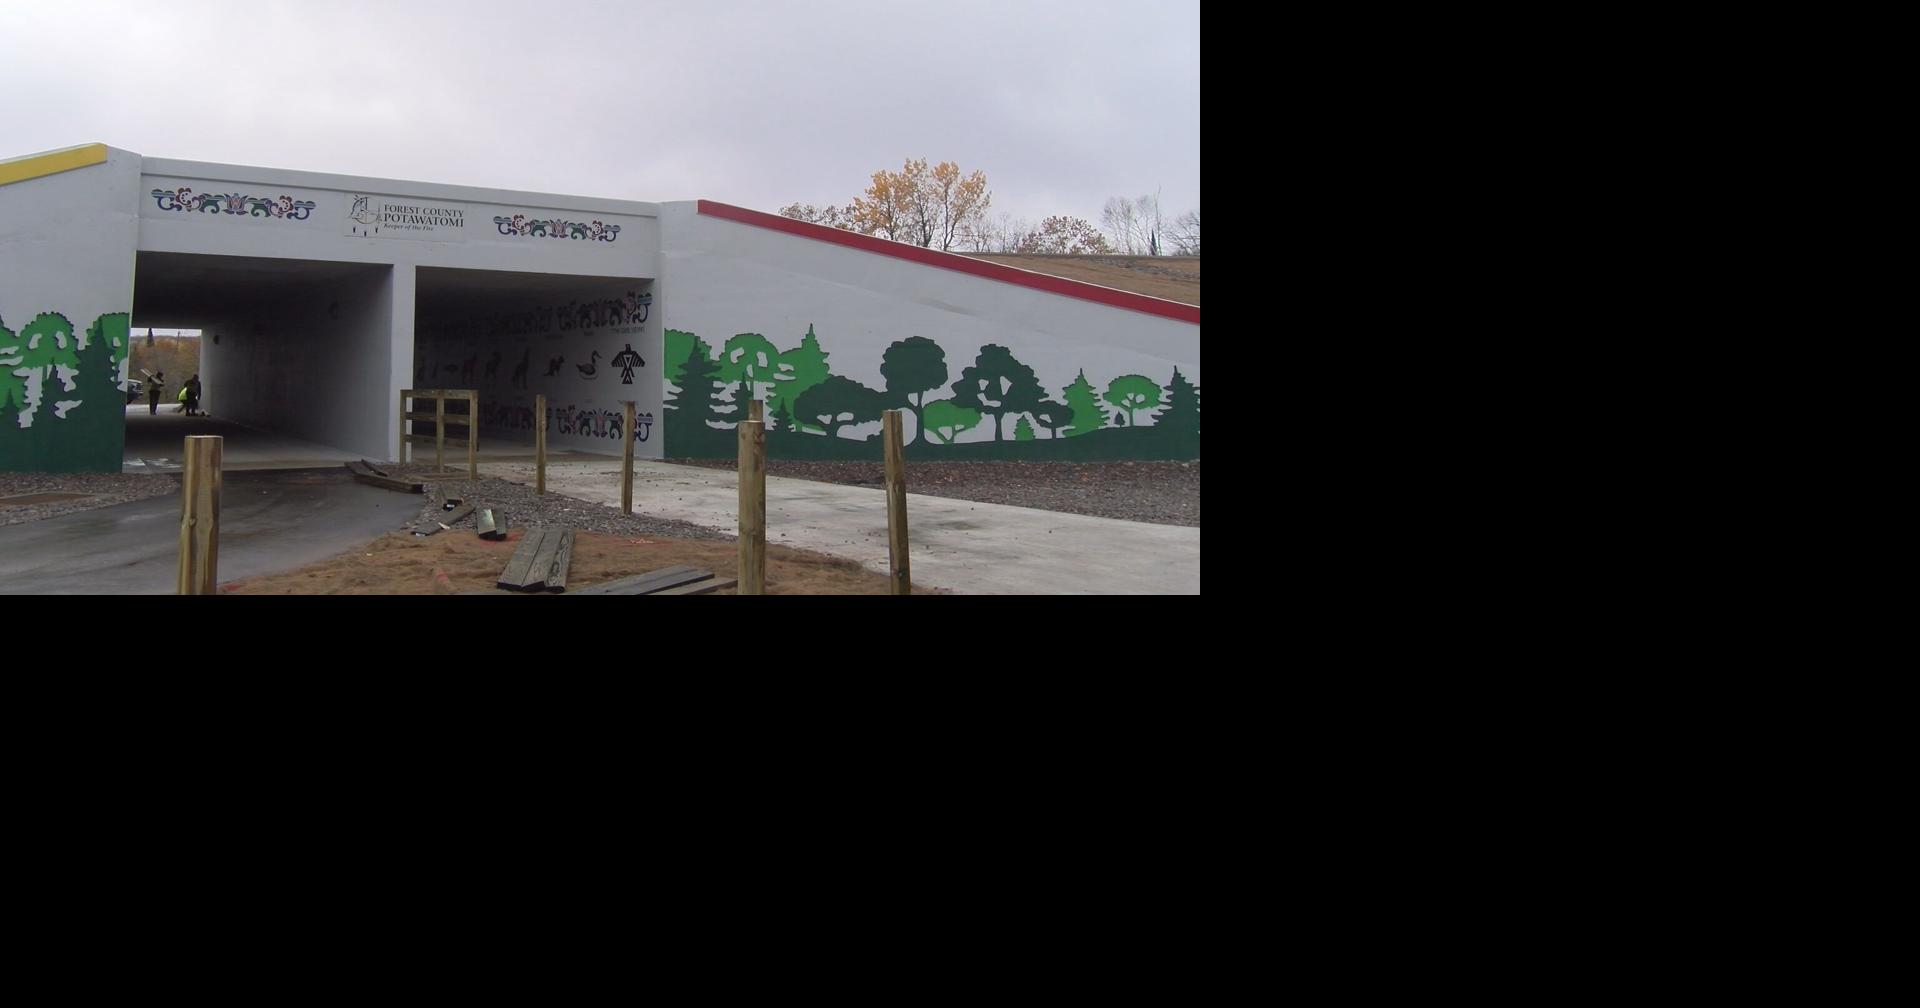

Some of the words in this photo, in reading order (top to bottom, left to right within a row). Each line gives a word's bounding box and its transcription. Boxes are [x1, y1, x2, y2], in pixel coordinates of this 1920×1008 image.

[384, 204, 420, 214] FOREST
[423, 207, 464, 217] COUNTY
[384, 213, 464, 227] POTAWATOMI
